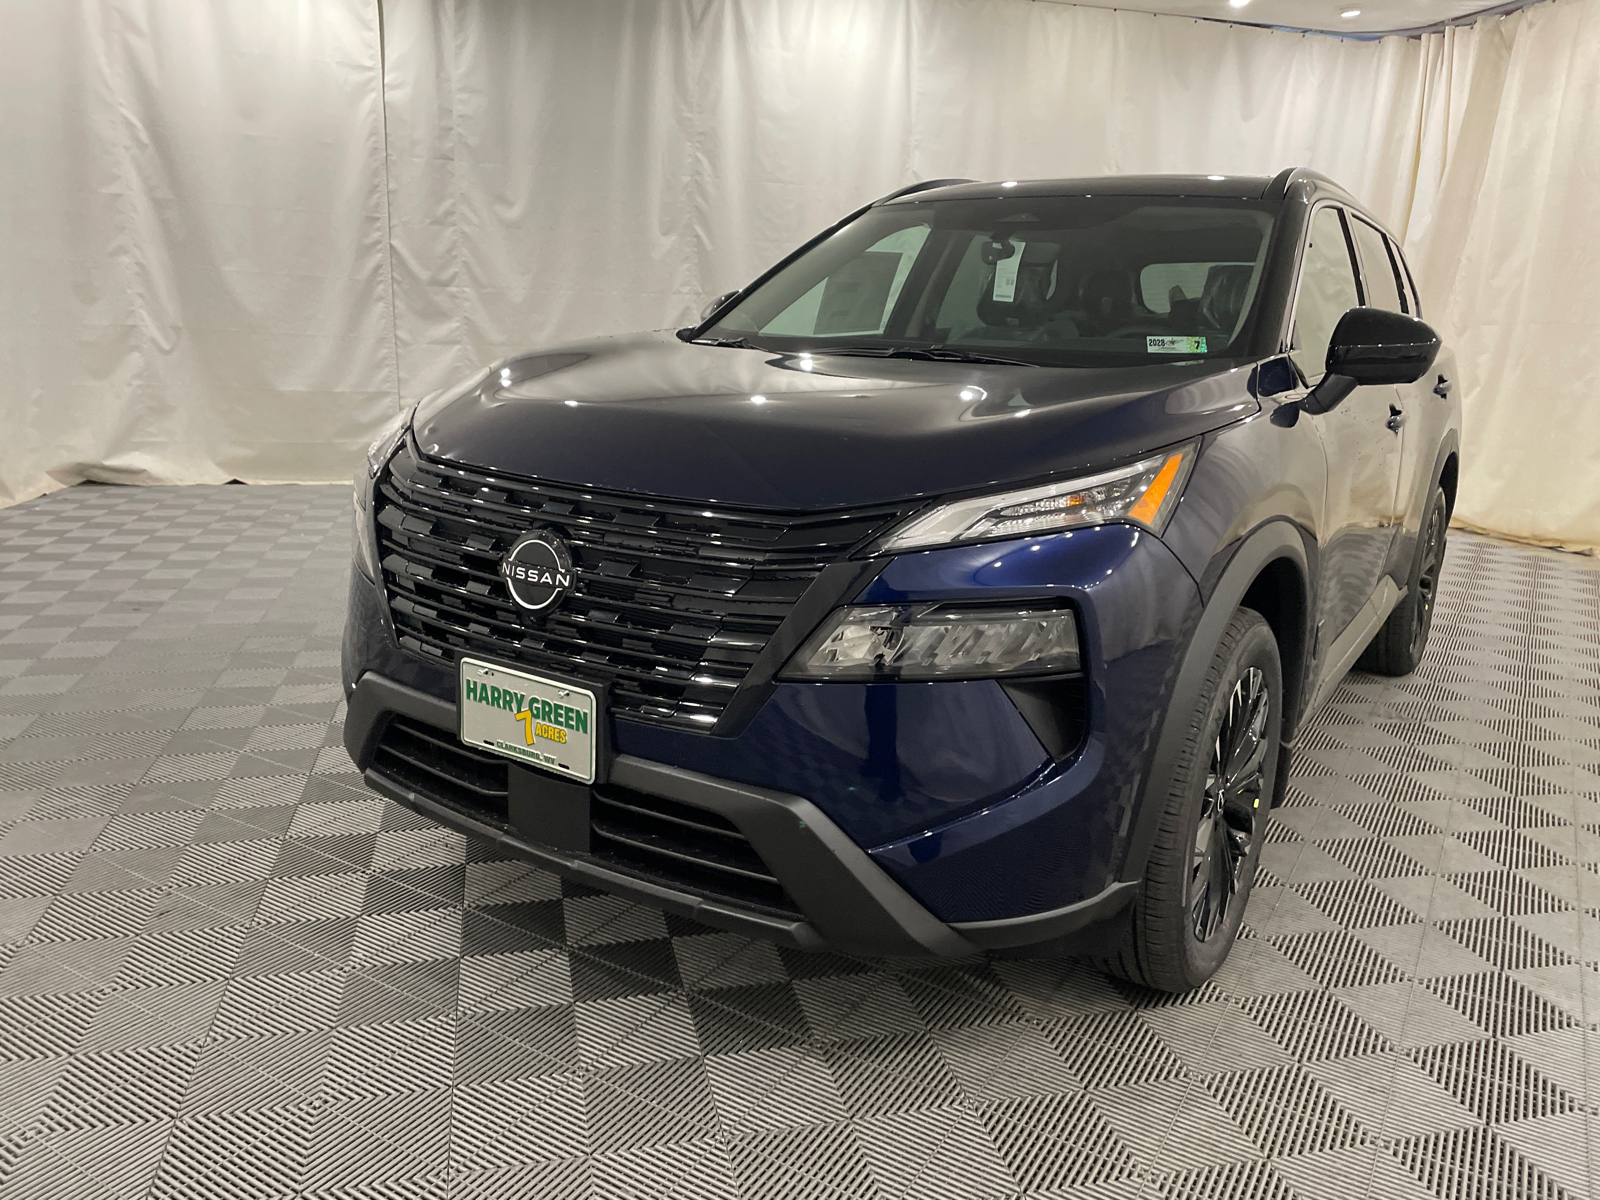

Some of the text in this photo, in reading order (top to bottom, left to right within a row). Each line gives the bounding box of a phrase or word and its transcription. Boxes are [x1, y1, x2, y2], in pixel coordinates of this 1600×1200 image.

[1148, 338, 1166, 347] 2028
[1194, 341, 1200, 350] 7
[502, 562, 570, 587] NISSAN
[465, 678, 589, 734] HARRY GREEN
[515, 709, 535, 746] 7
[535, 722, 567, 744] ACRES
[543, 754, 557, 765] WV
